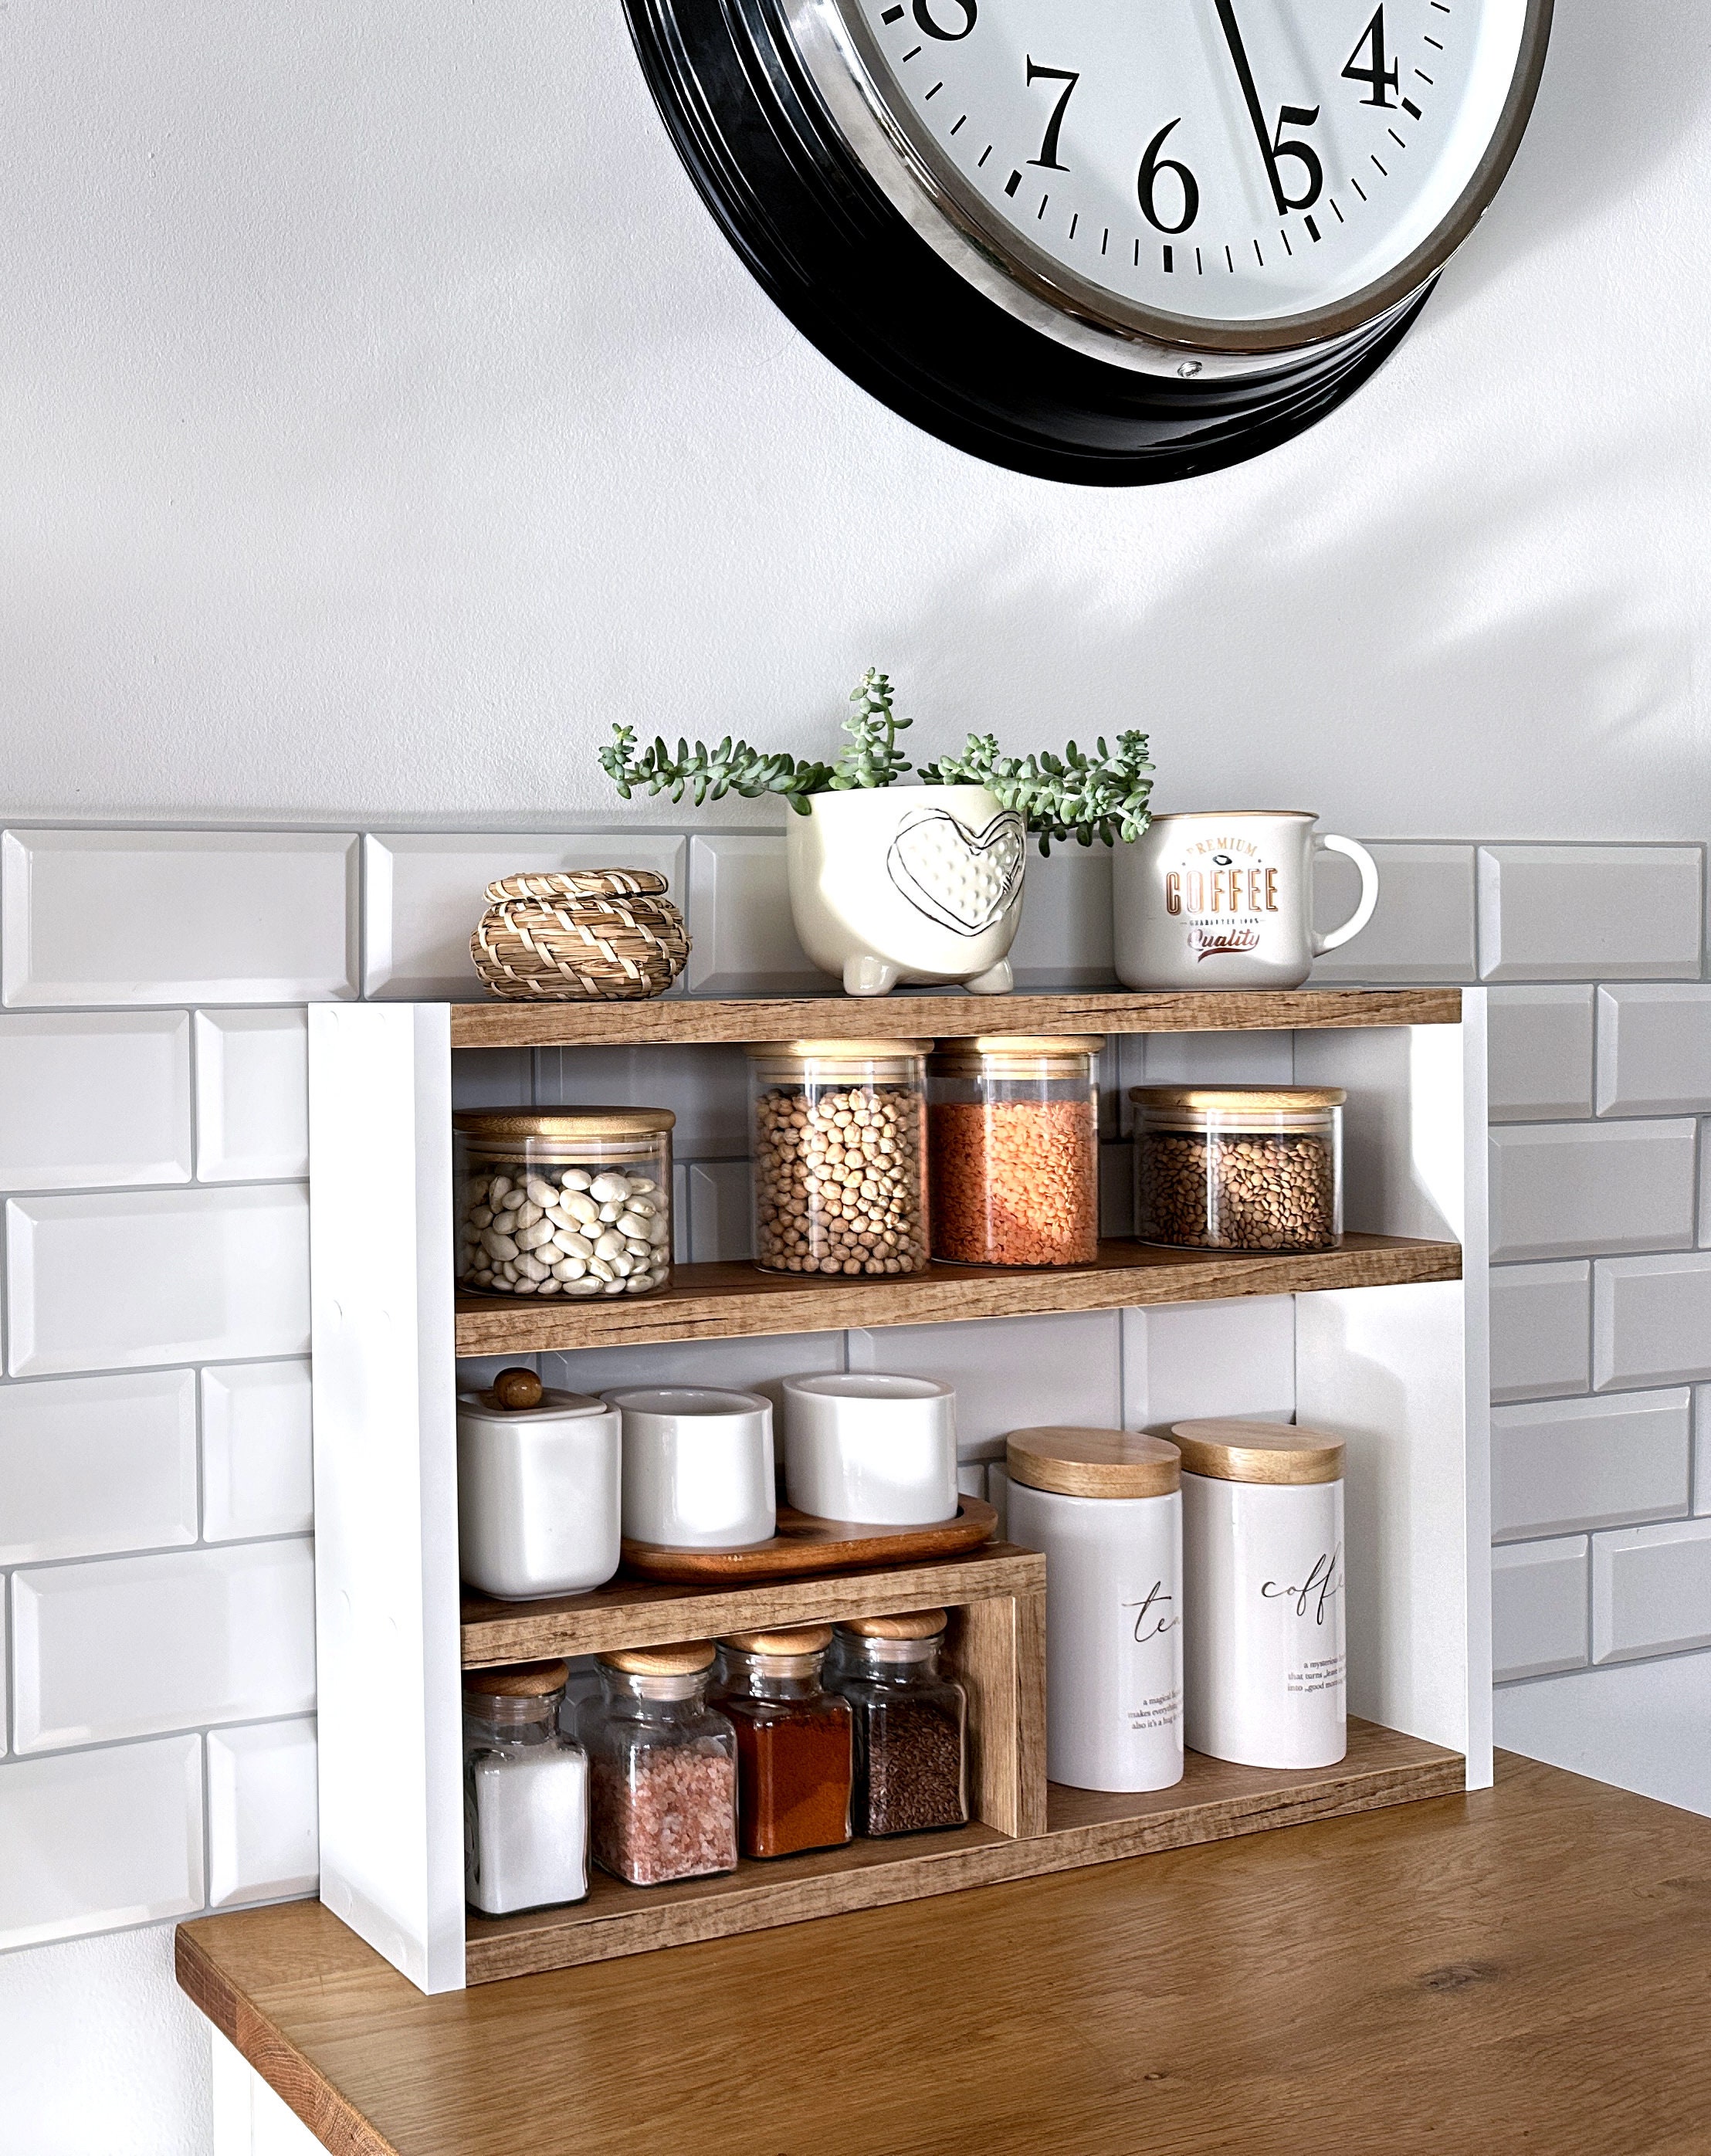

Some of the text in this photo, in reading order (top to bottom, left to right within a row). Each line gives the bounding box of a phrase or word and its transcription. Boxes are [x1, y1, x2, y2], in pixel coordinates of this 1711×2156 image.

[1340, 2, 1398, 109] 4
[1026, 53, 1080, 172] 7
[1272, 105, 1323, 210] 5
[1137, 117, 1199, 234] 6
[1166, 867, 1279, 917] COFFEE
[1186, 837, 1258, 857] PREMIUM
[1187, 929, 1260, 963] Quality
